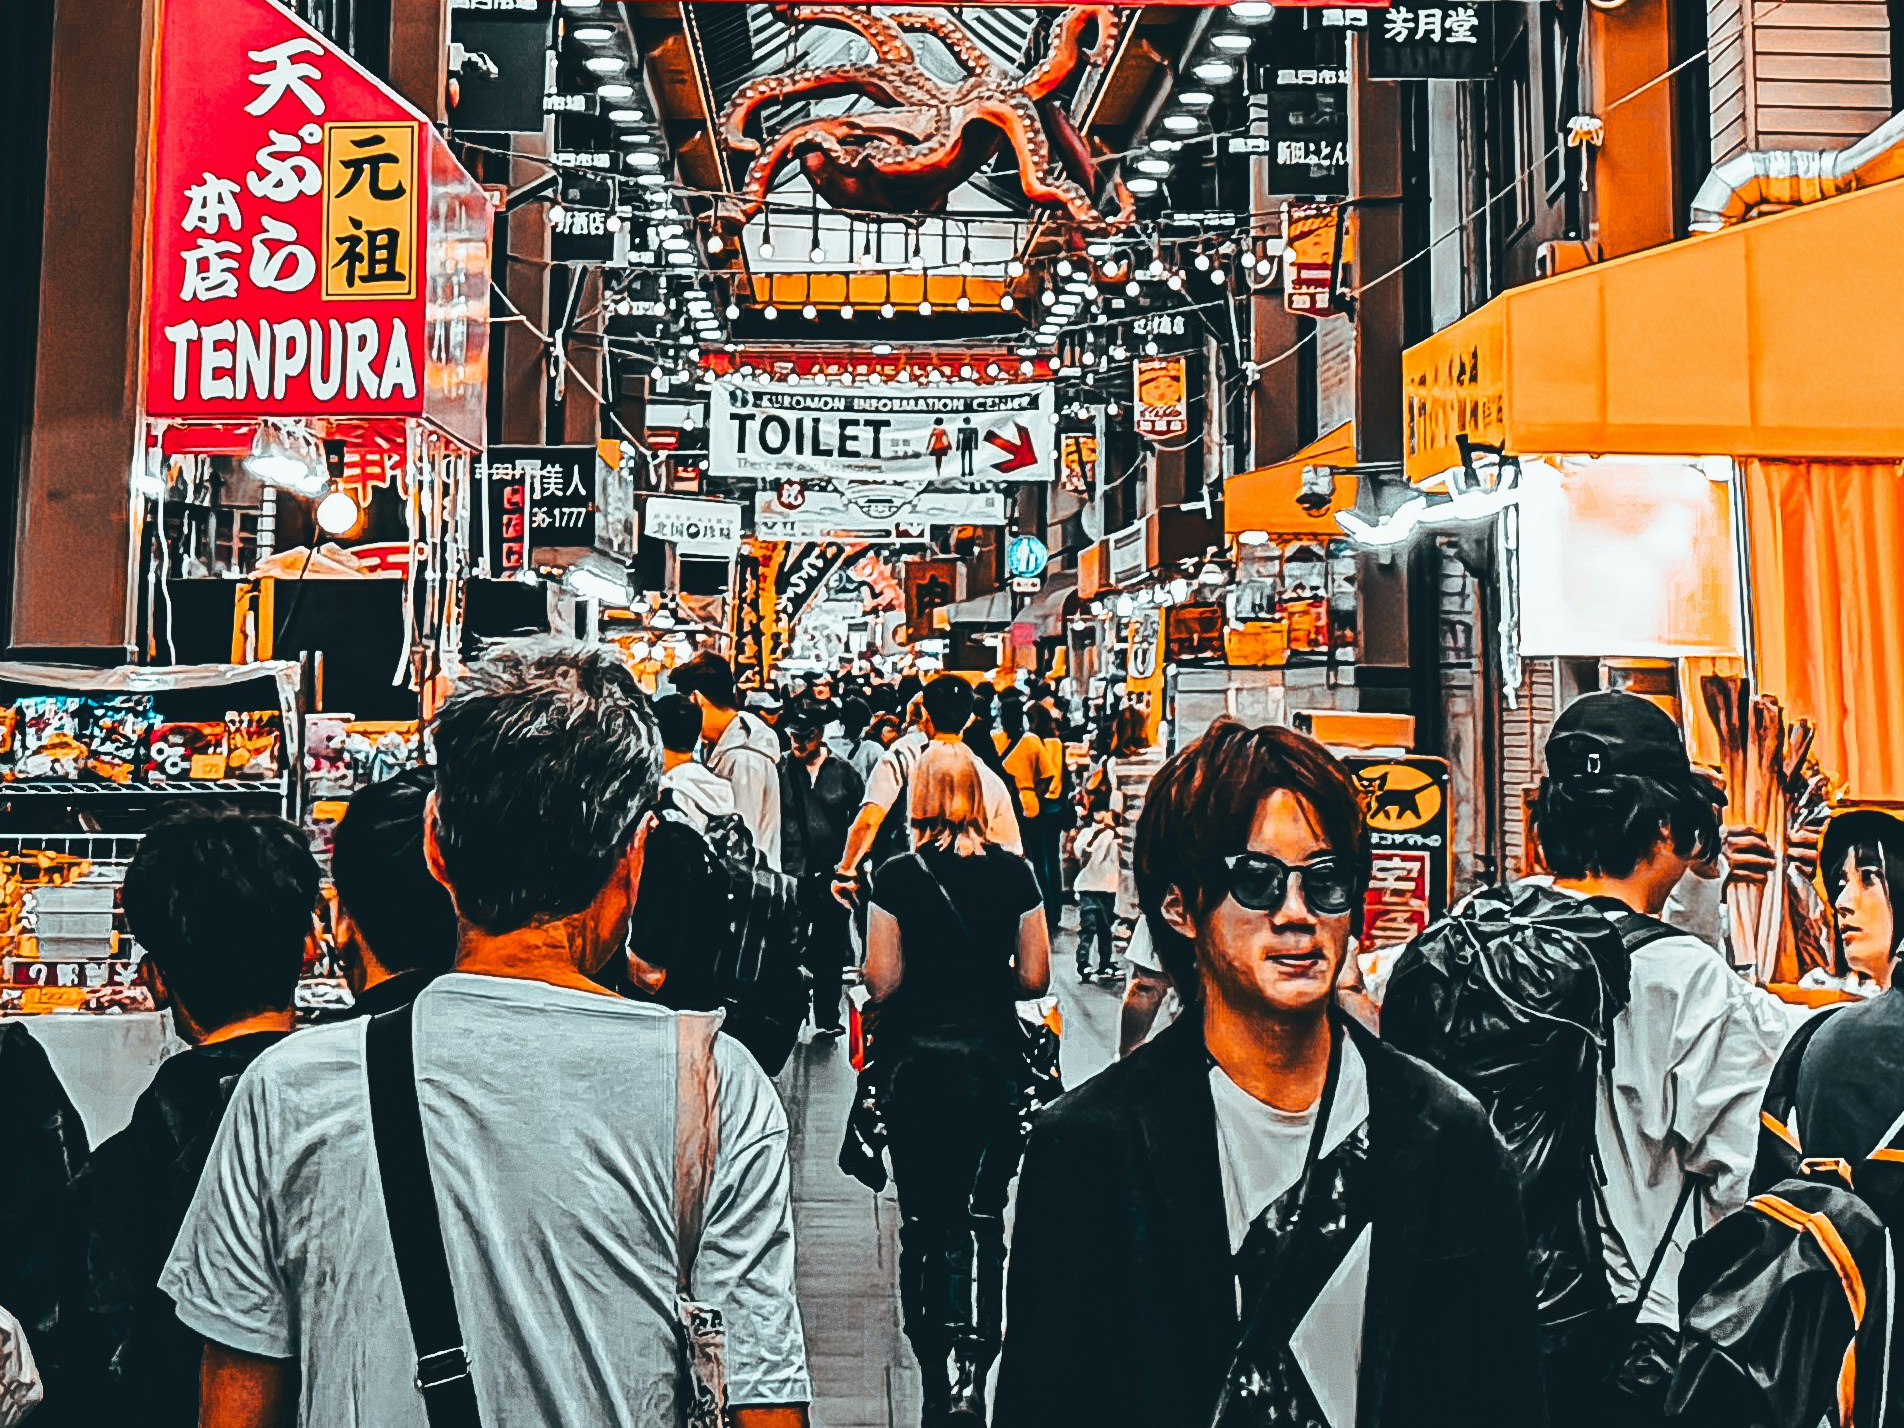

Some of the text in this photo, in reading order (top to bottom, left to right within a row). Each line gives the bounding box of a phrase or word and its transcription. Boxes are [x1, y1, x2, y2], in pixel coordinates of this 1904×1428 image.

[1383, 5, 1480, 45] 芳月堂
[243, 37, 326, 294] 天ぷら
[179, 171, 244, 303] 本店
[330, 134, 408, 288] 元祖
[164, 316, 418, 403] TENPURA
[761, 394, 846, 411] KUROMON
[853, 396, 965, 412] INFORMATION
[729, 412, 892, 460] TOILET
